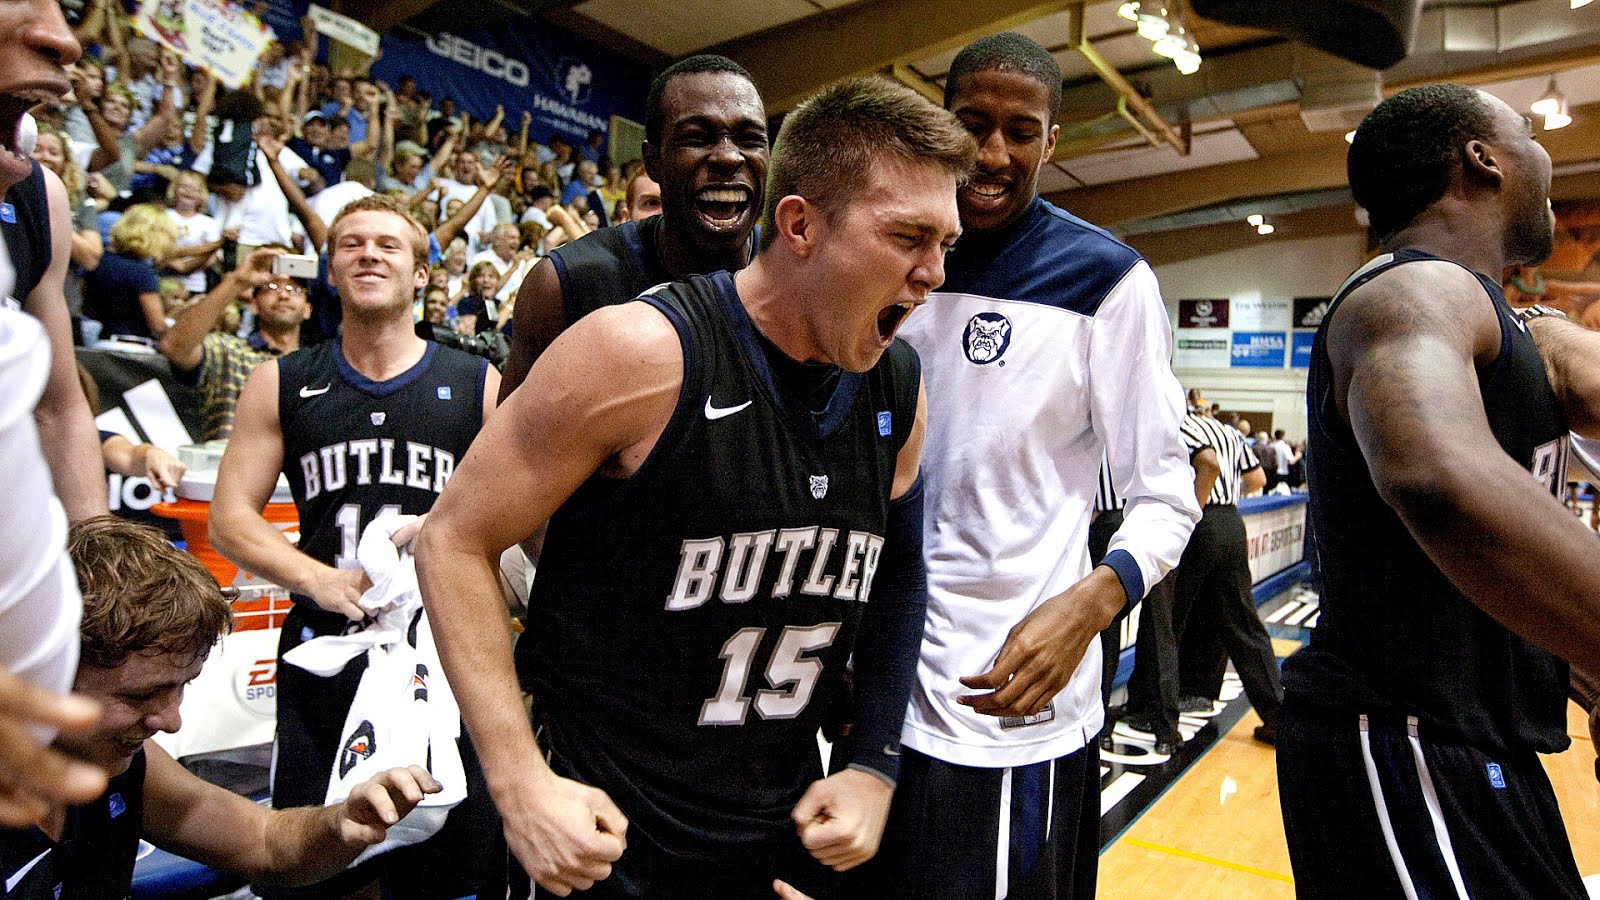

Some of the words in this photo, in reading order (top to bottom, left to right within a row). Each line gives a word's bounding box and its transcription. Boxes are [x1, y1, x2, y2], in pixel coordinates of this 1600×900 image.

[425, 31, 530, 88] GEICO
[300, 438, 455, 501] BUTLER
[664, 525, 885, 611] BUTLER
[697, 622, 843, 726] 15
